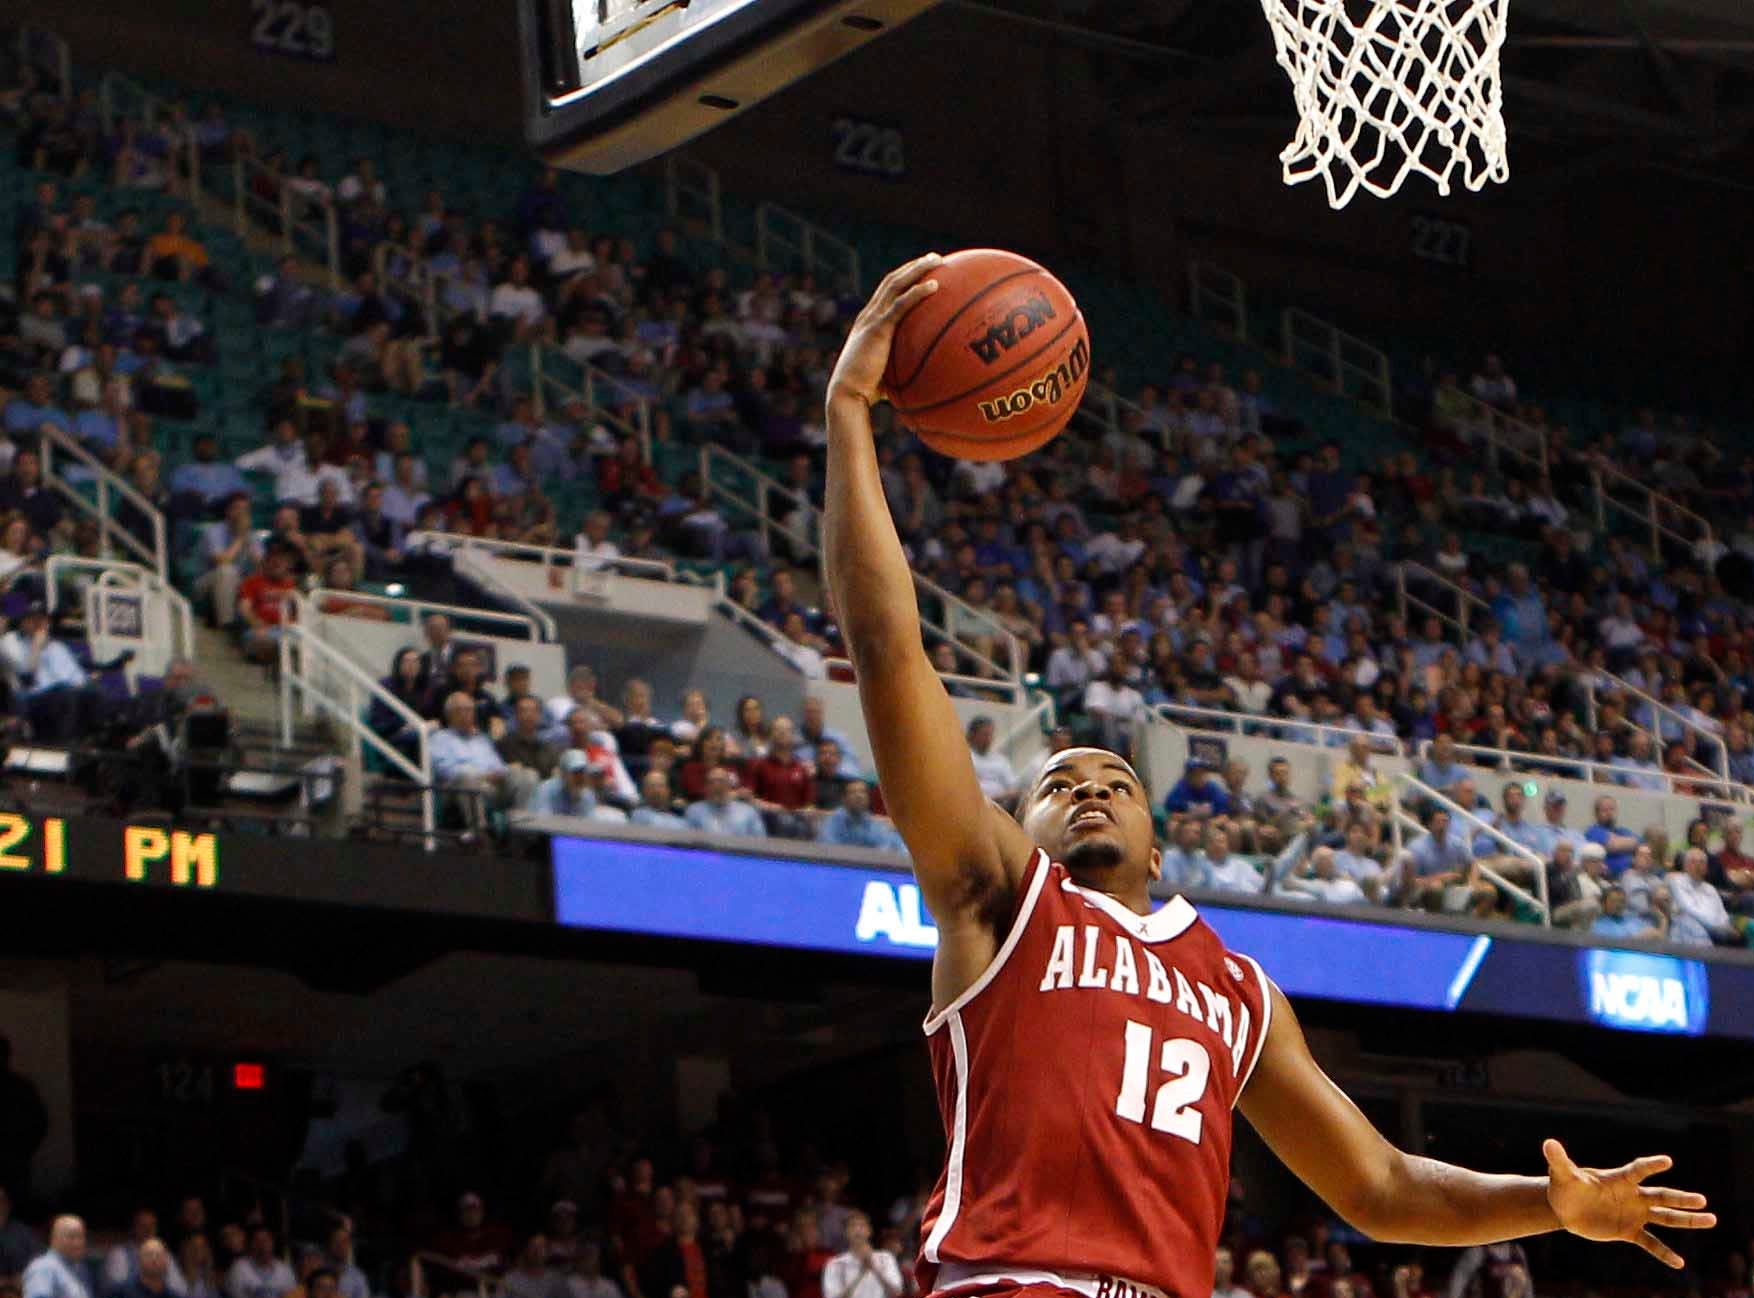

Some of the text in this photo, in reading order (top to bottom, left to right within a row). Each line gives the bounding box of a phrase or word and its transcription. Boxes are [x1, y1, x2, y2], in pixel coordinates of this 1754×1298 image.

[250, 0, 334, 57] 229
[833, 118, 904, 174] 228
[1410, 216, 1471, 265] 227
[969, 291, 1056, 364] NCAA
[978, 337, 1089, 422] Wilson
[124, 824, 216, 887] PM
[1039, 924, 1250, 1078] ALABAMA
[1591, 971, 1688, 1028] NCAA
[1115, 1019, 1211, 1144] 12
